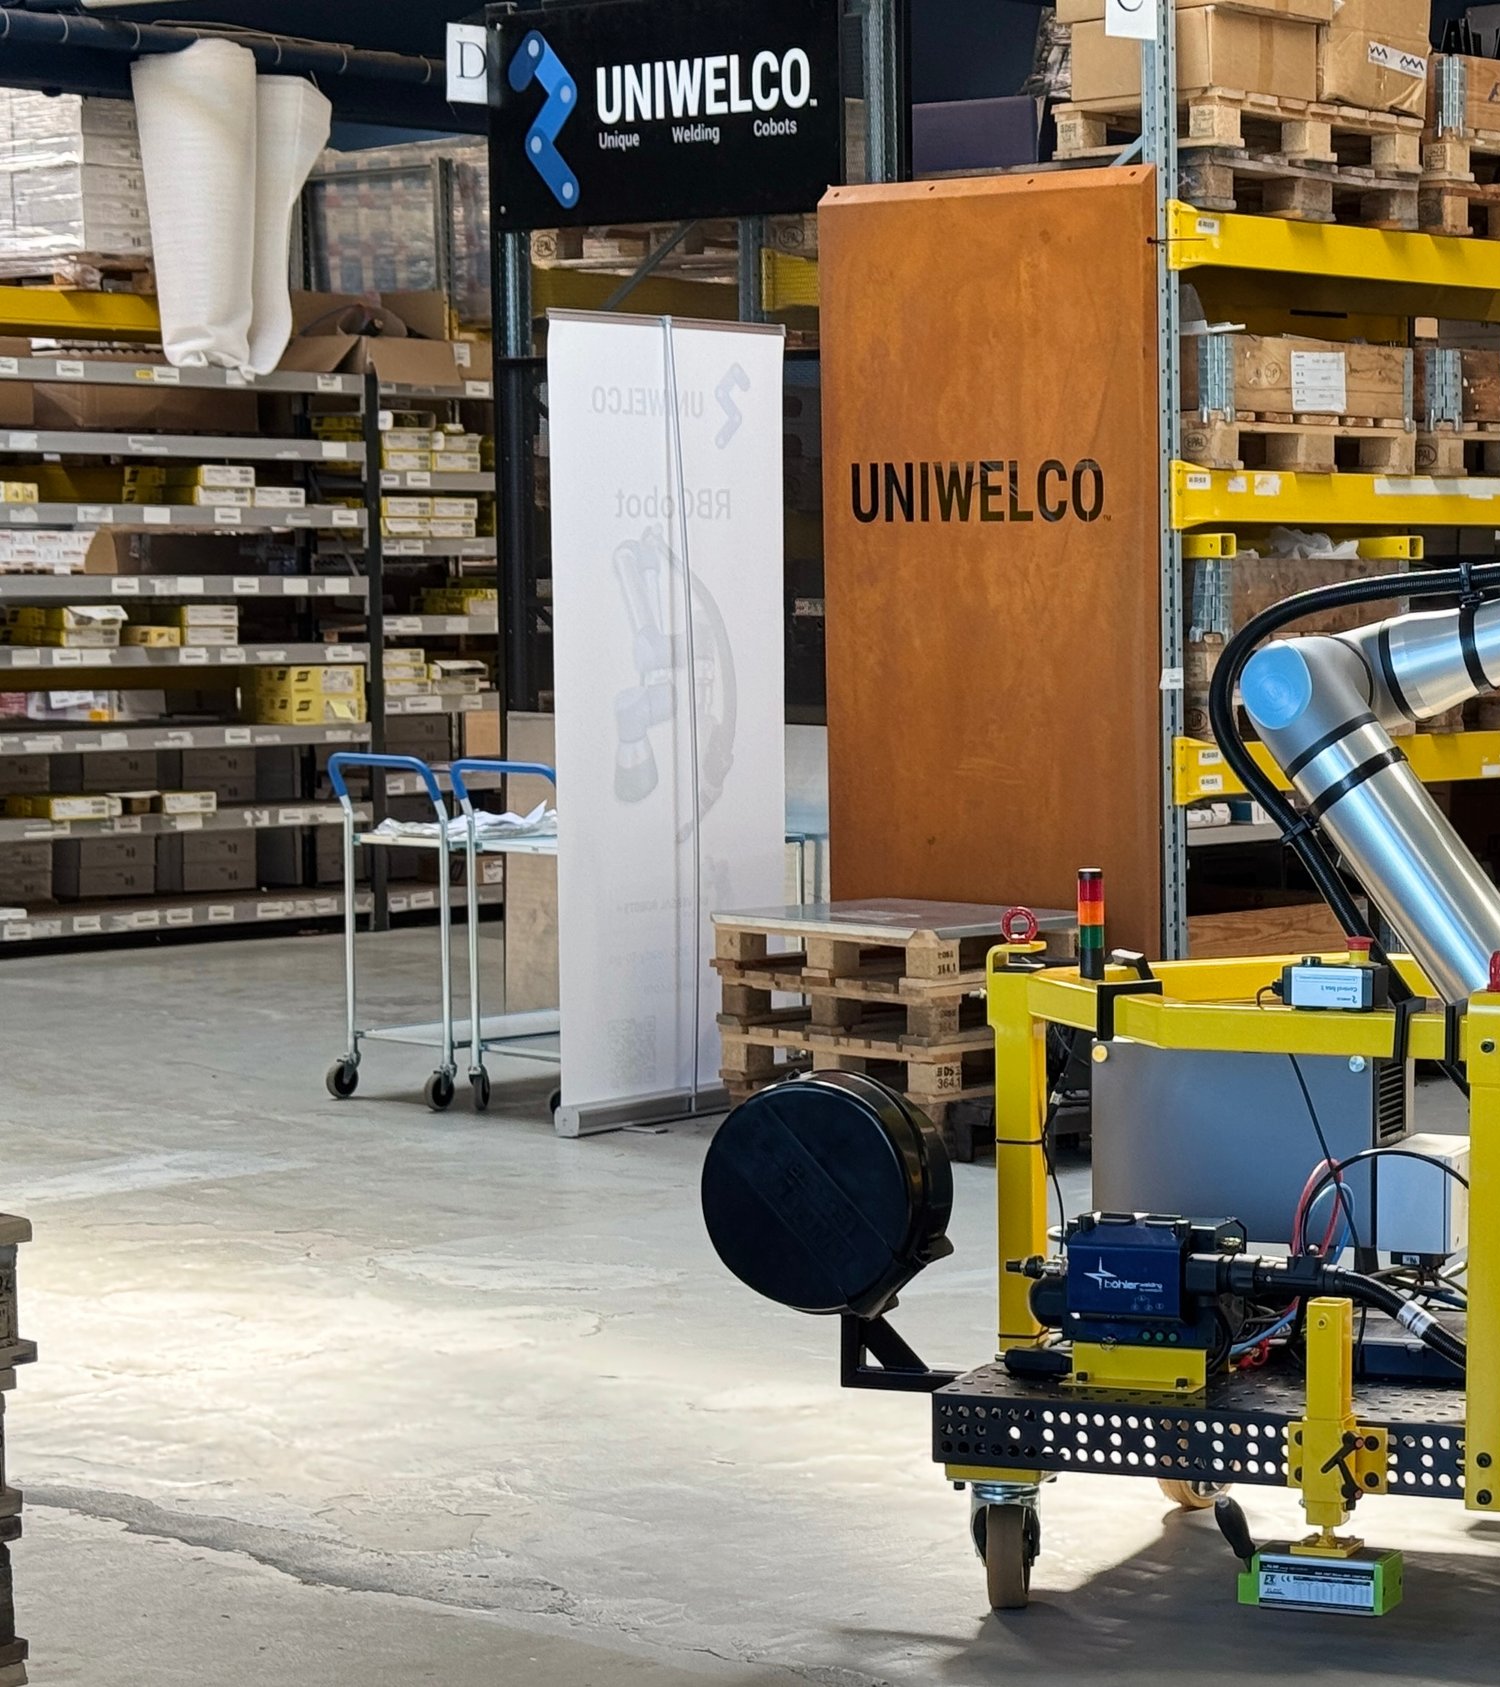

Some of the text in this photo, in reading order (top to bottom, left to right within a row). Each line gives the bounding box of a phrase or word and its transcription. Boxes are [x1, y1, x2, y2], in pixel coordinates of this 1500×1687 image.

[456, 40, 486, 80] D
[595, 47, 811, 125] UNIWELCO
[598, 118, 797, 152] Unique Welding Cobots
[851, 458, 1105, 523] UNIWELCO
